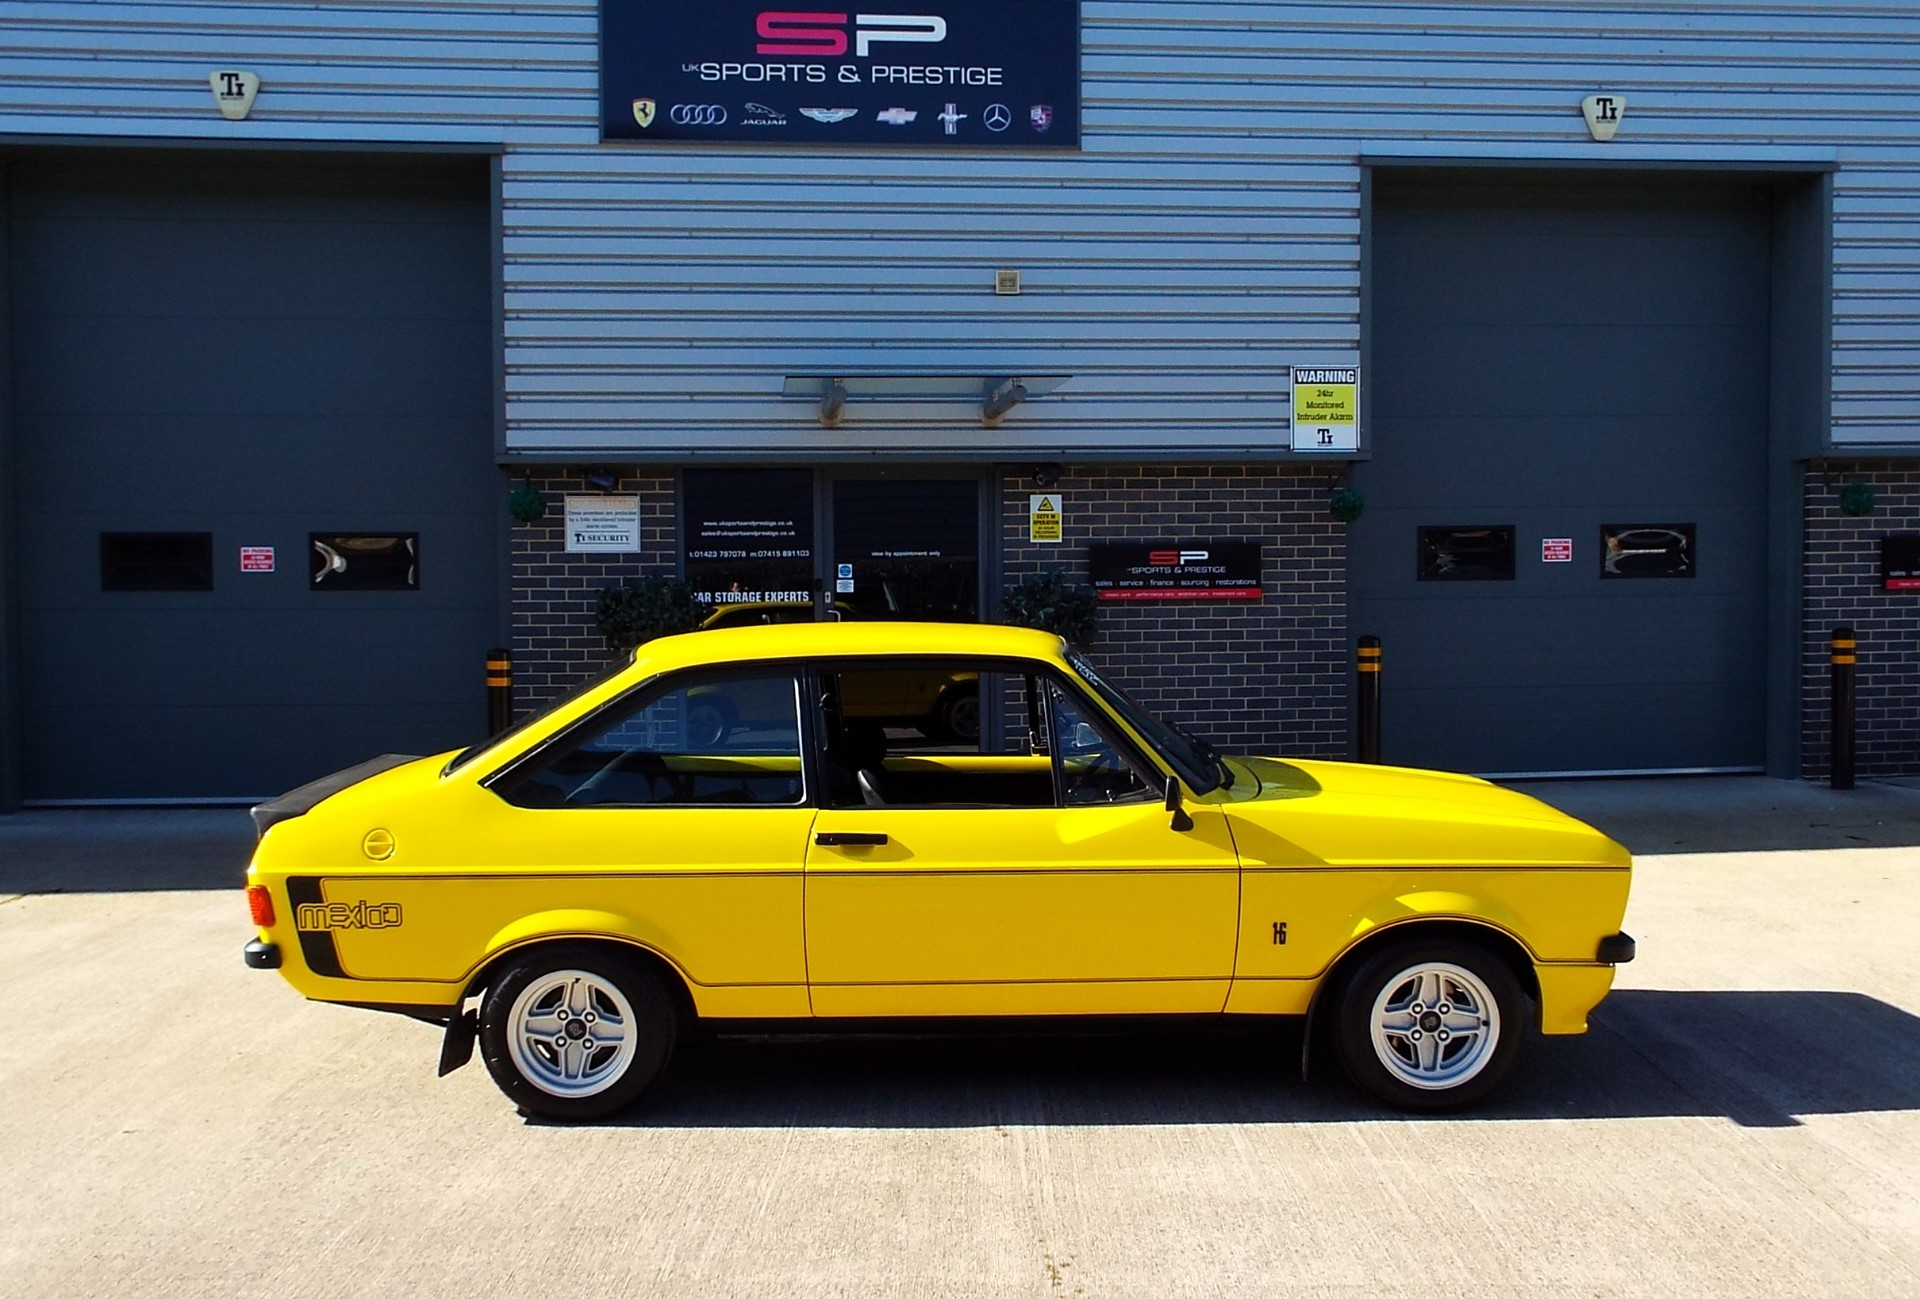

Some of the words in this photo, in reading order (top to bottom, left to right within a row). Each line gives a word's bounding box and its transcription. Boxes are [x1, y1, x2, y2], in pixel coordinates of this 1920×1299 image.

[756, 12, 947, 57] SP
[700, 62, 826, 83] SPORTS
[838, 65, 861, 83] &
[872, 65, 1003, 86] PRESTIGE
[1296, 370, 1355, 383] WARNING
[1317, 389, 1334, 397] 24hr
[1306, 401, 1344, 409] Monitored
[1297, 413, 1327, 421] Intruder
[1329, 413, 1354, 421] Alarm
[893, 550, 927, 558] appointment
[1149, 551, 1208, 565] SP
[1131, 566, 1171, 574] SPORTS
[1180, 579, 1209, 588] sourcing
[1216, 578, 1256, 586] restorations
[715, 592, 761, 602] STORAGE
[765, 591, 809, 602] EXPERTS
[298, 900, 403, 931] mexico
